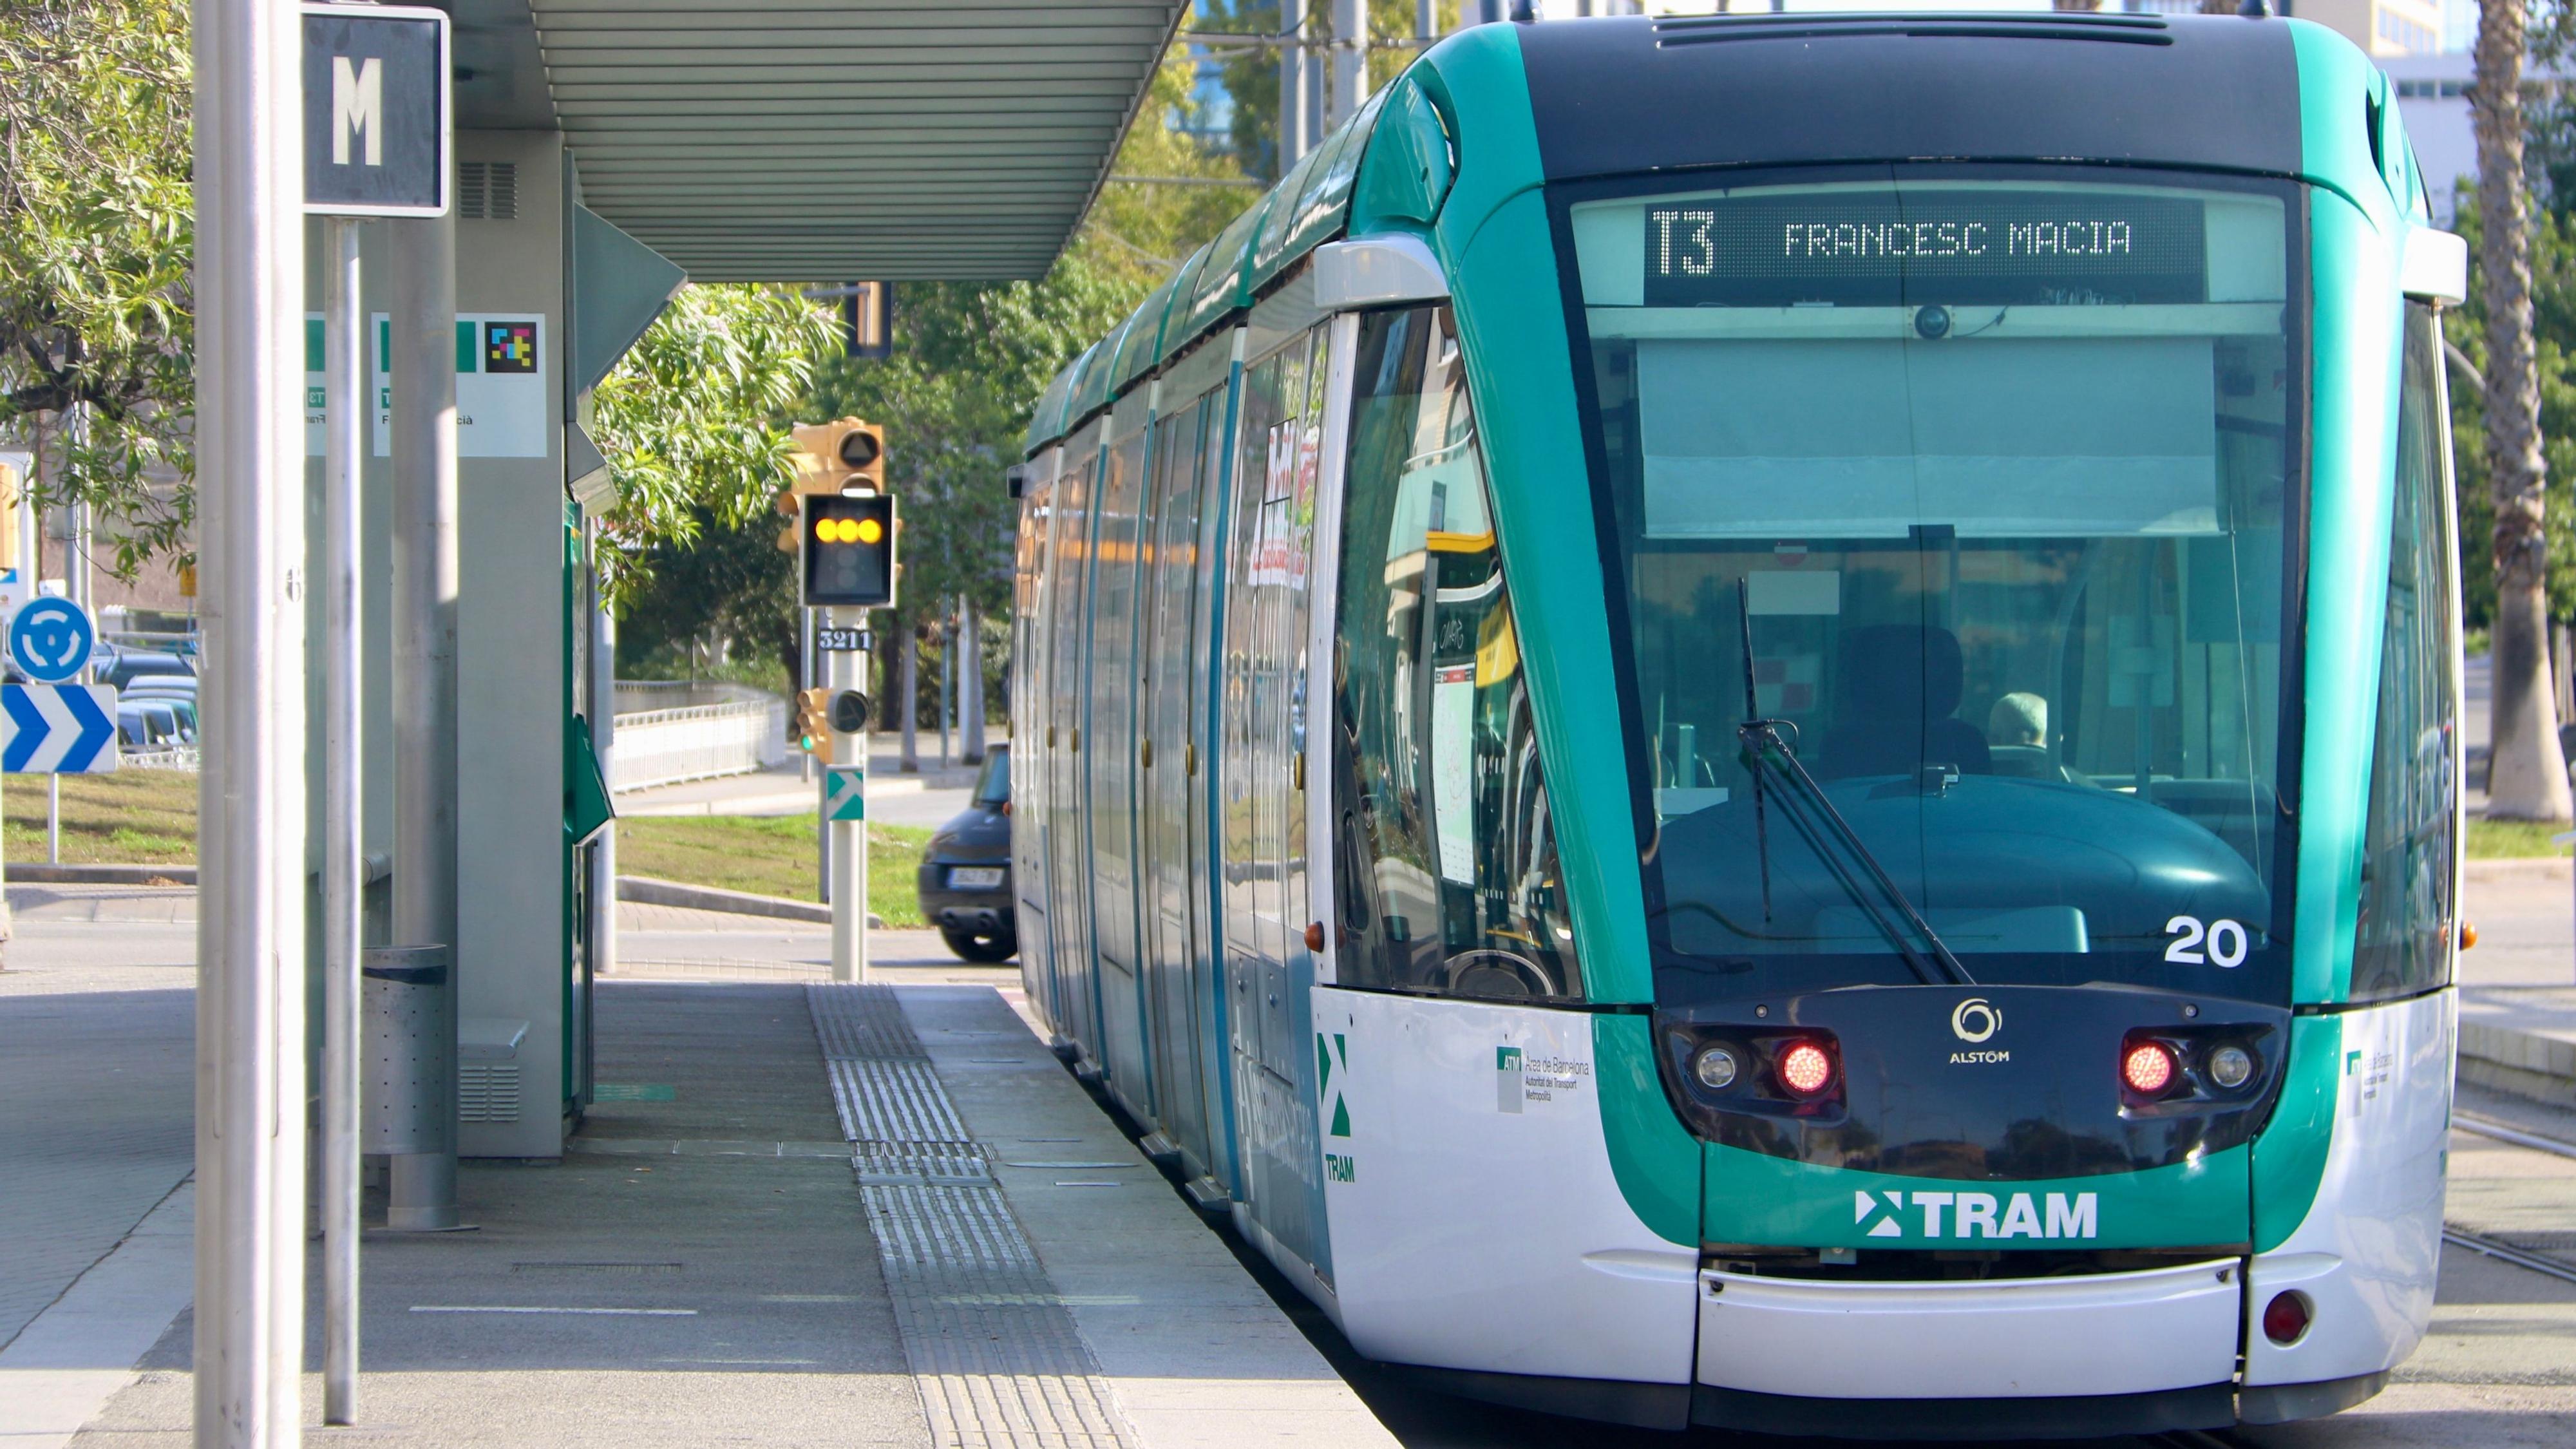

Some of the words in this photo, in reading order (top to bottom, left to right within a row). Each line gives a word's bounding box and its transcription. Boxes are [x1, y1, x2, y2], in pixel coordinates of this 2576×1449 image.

[333, 56, 381, 167] M
[1653, 211, 1714, 275] T3
[1785, 222, 1987, 256] FRANCESC
[2009, 221, 2130, 255] MACIA
[2164, 915, 2248, 968] 20
[1504, 1054, 1520, 1072] ATM
[1542, 1056, 1551, 1073] de
[1553, 1057, 1589, 1075] Barcelona
[1949, 1050, 2010, 1064] ALSTOM
[1526, 1075, 1545, 1087] Autoritat
[1554, 1077, 1577, 1091] Transport
[1325, 1153, 1355, 1183] TRAM
[1911, 1191, 2098, 1238] TRAM
